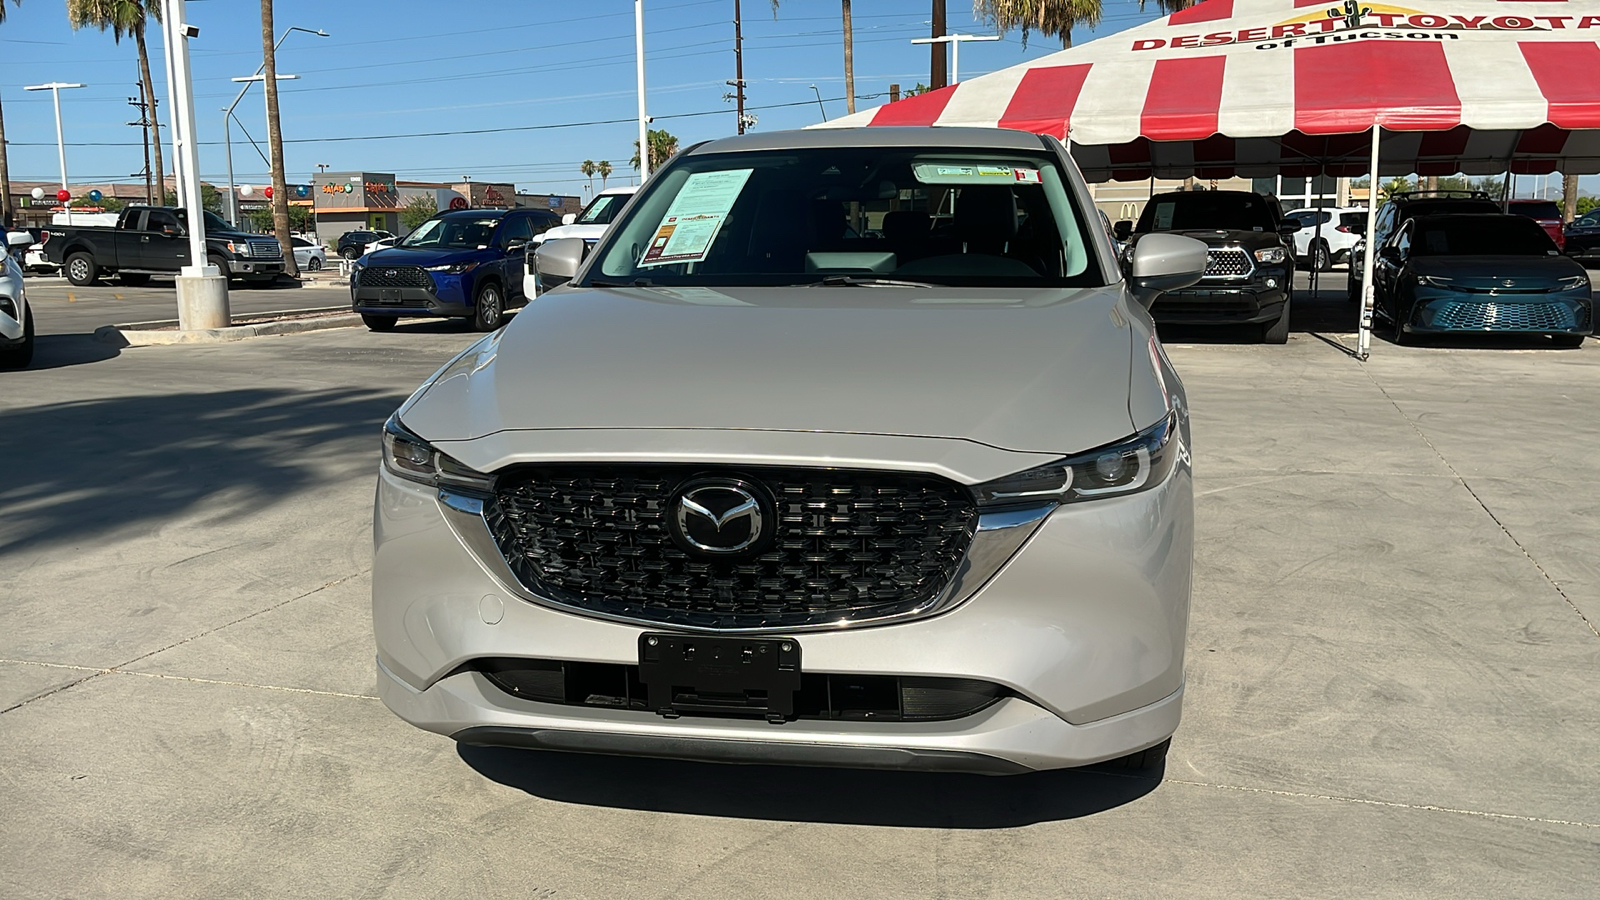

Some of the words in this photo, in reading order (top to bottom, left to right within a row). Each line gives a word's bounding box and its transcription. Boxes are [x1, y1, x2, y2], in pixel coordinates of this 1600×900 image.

[1131, 16, 1346, 51] DESERT
[1367, 12, 1600, 29] TOYOTA
[1255, 38, 1298, 50] of
[1305, 31, 1459, 44] Tucson
